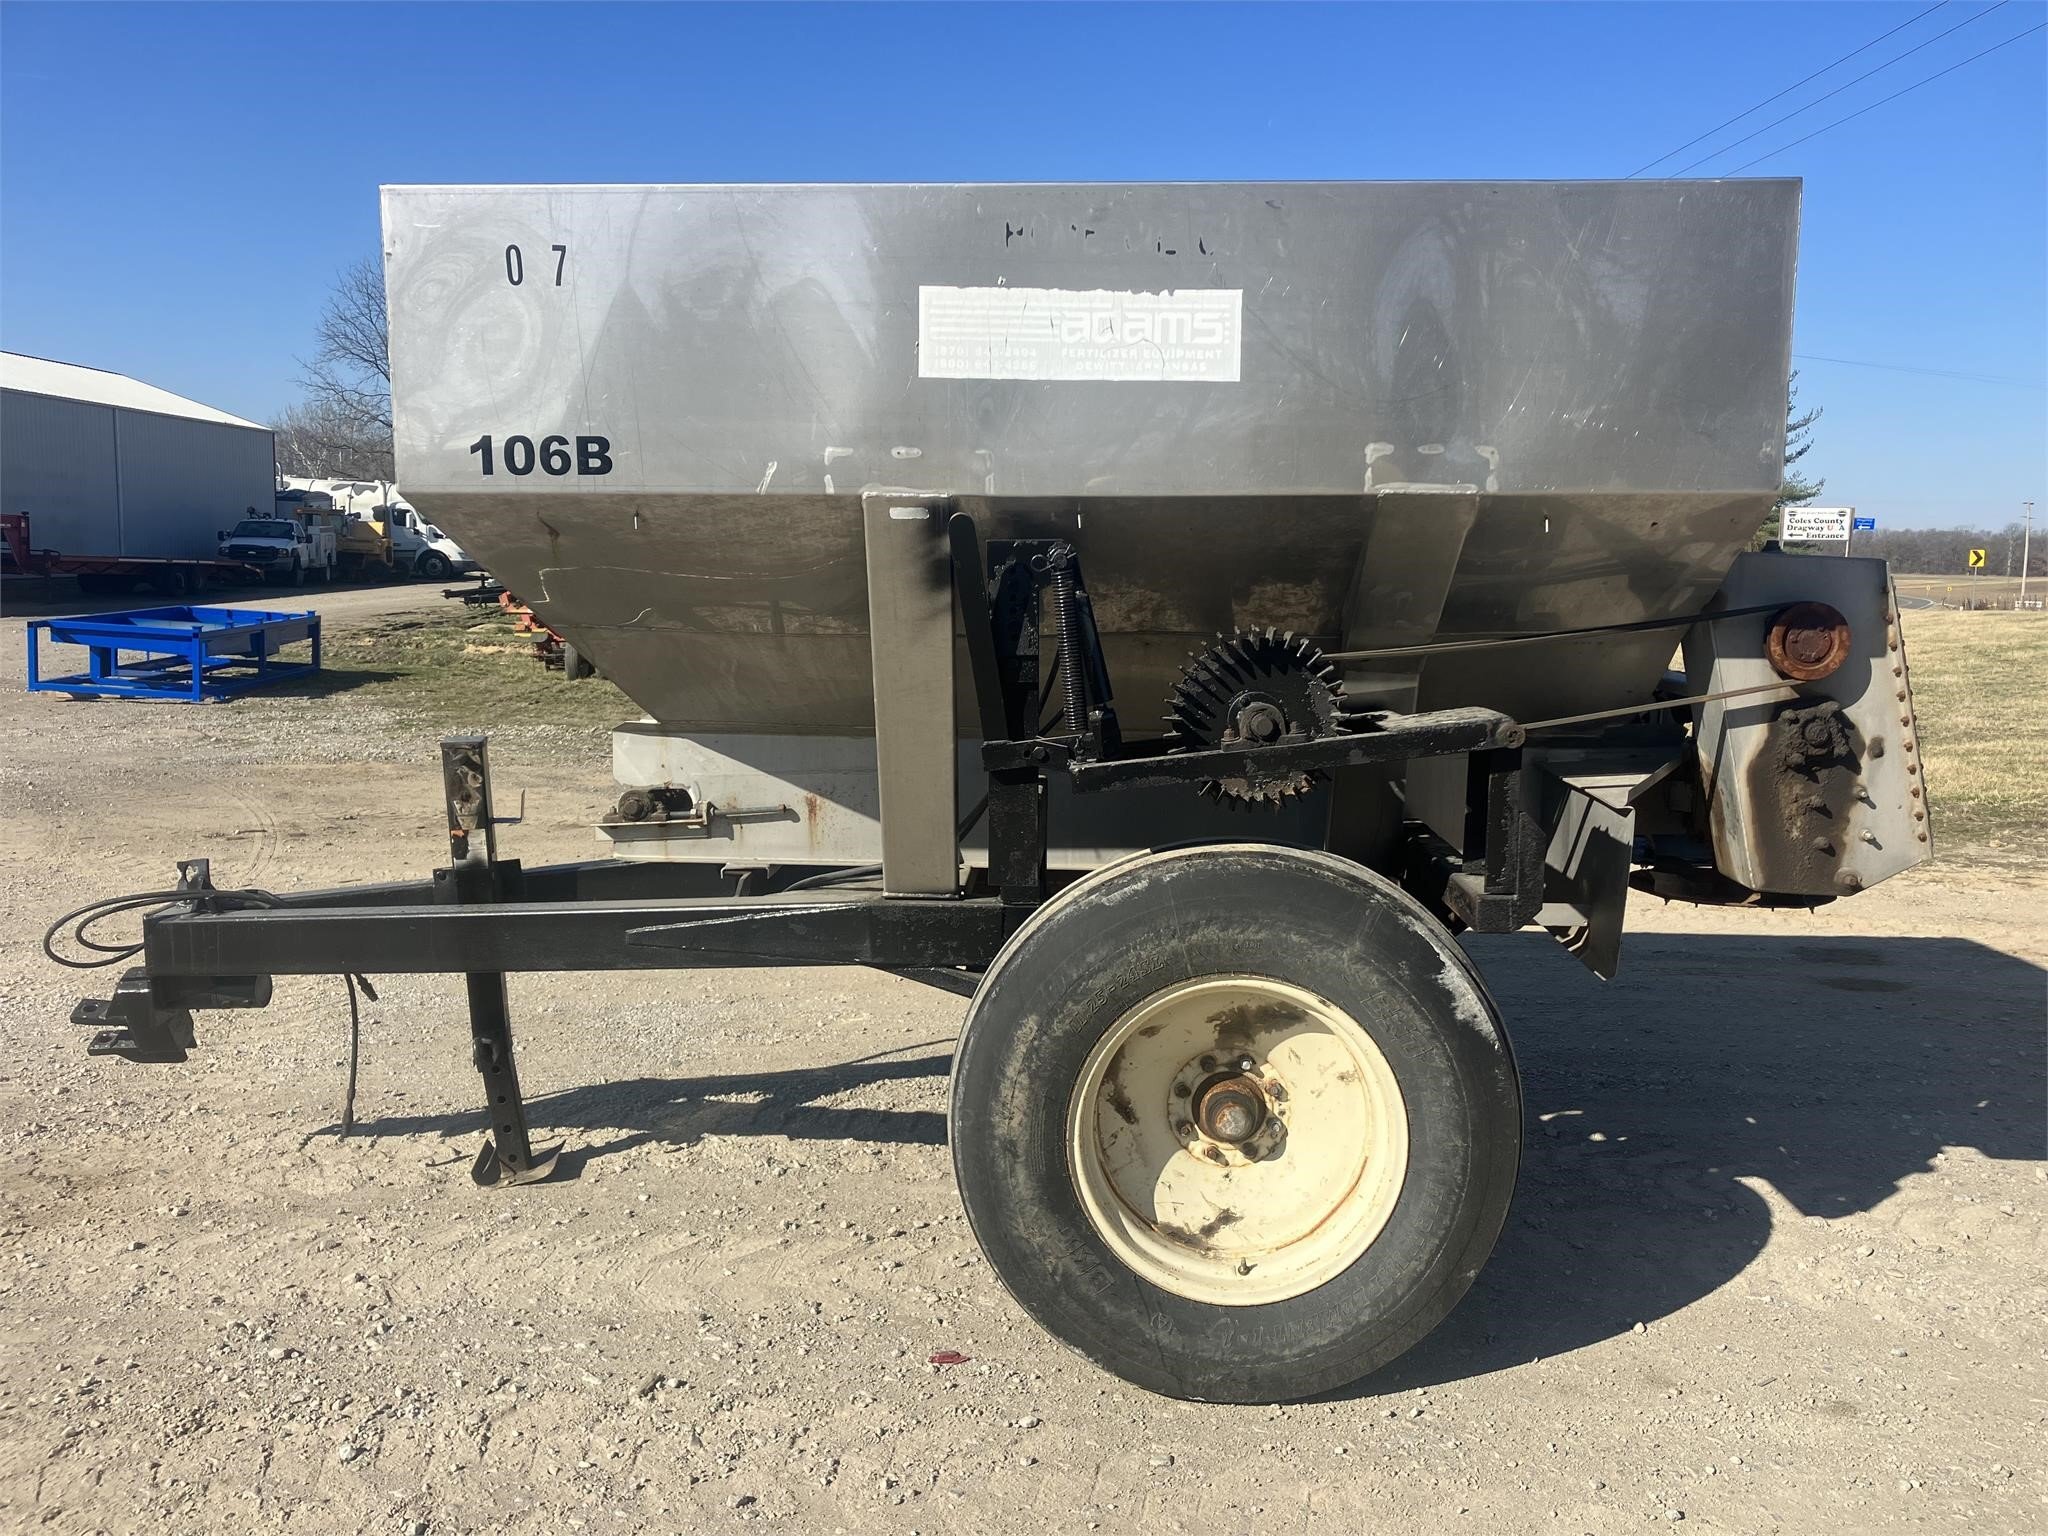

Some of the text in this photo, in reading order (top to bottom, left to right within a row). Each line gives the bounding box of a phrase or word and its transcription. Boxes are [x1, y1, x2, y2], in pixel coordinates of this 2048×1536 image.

[505, 244, 567, 287] 0 7
[1060, 311, 1222, 344] adams
[1062, 347, 1223, 360] FERTILIZER EQUIPMENT
[470, 434, 614, 476] 106B
[1814, 517, 1844, 525] County
